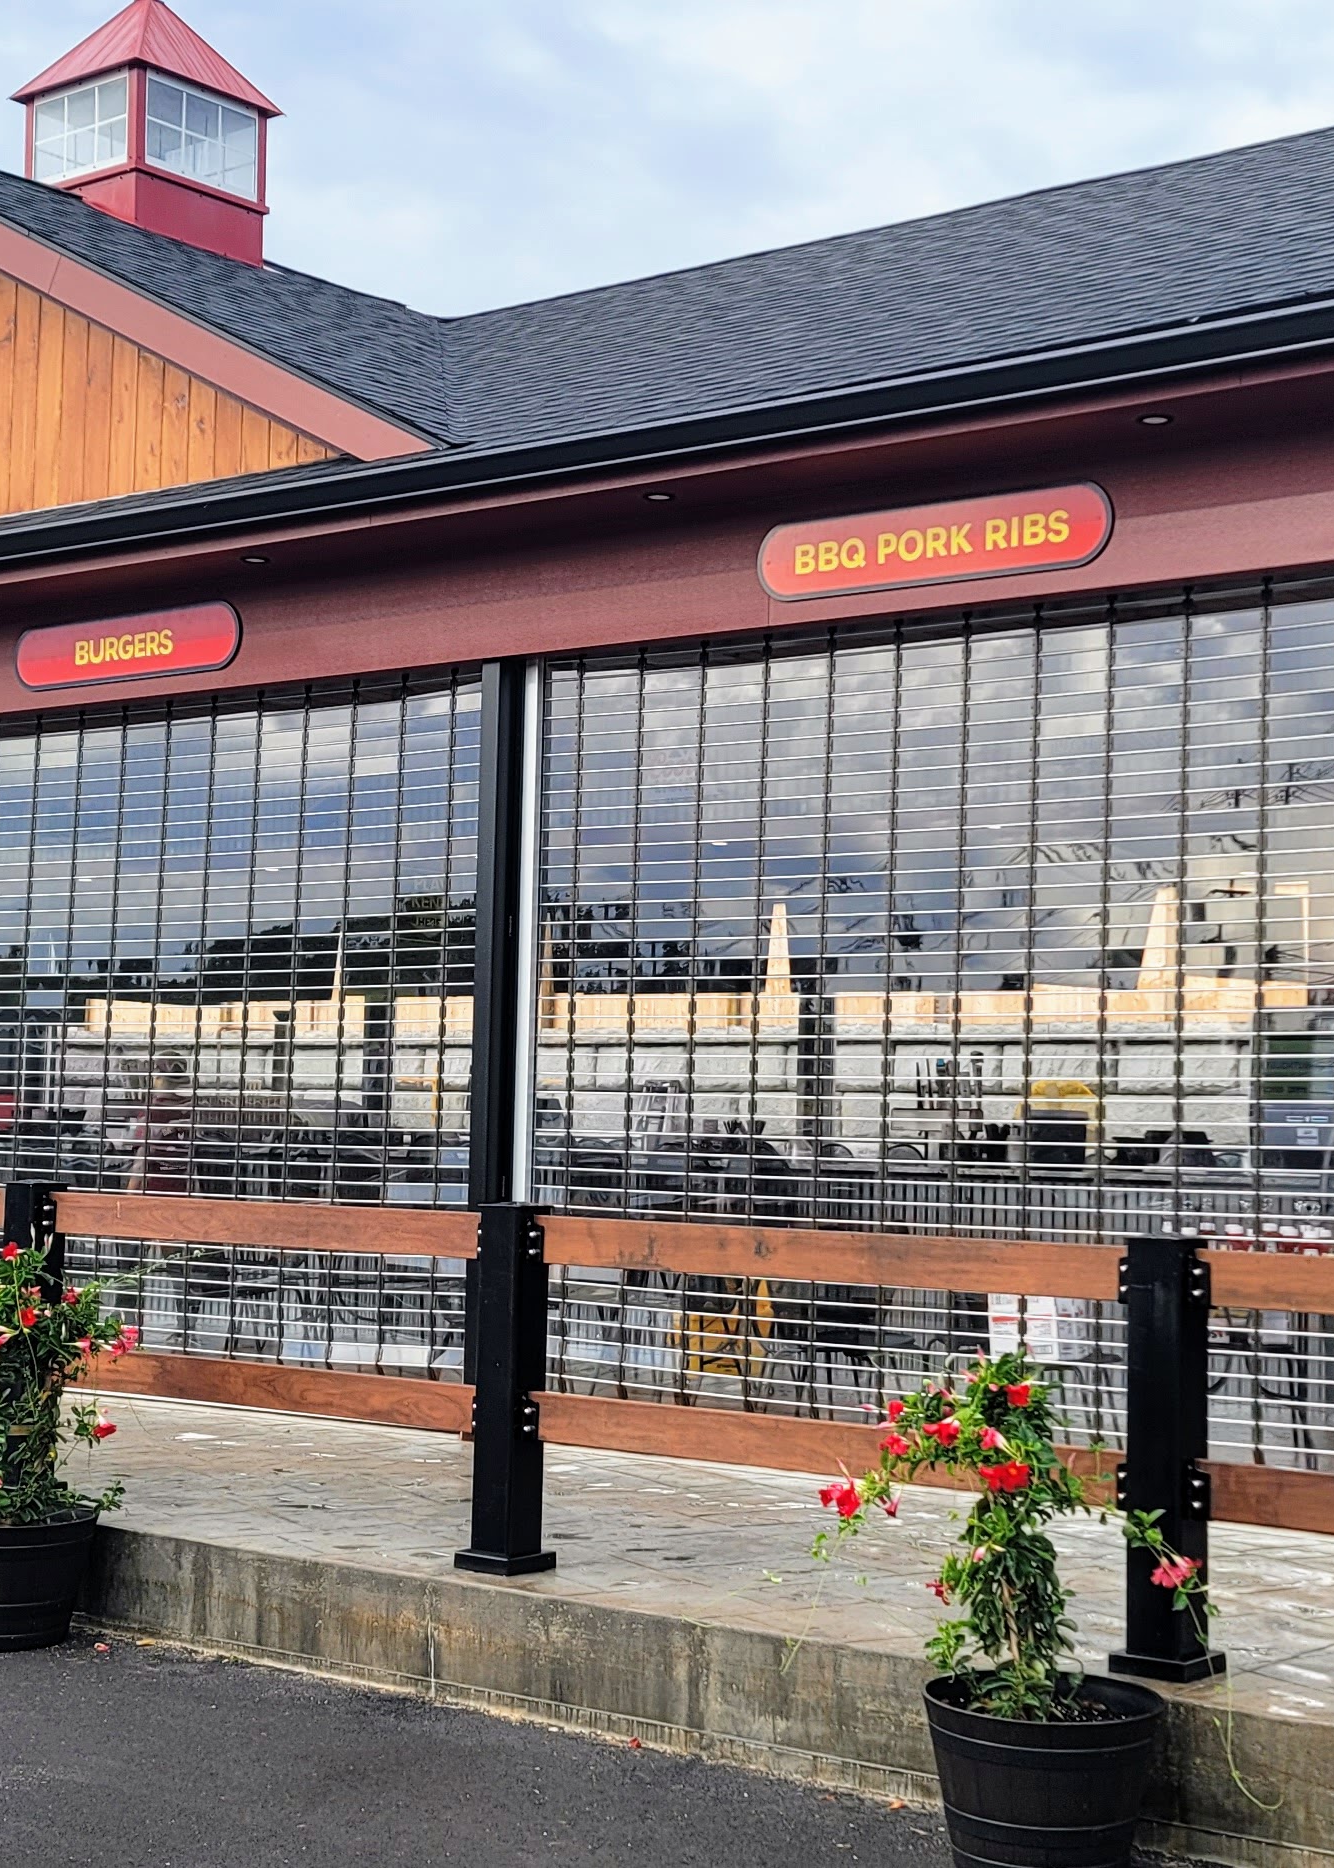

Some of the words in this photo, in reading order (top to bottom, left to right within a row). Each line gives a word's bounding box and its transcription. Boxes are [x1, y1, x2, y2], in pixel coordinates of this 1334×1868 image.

[794, 538, 867, 576] BBQ
[877, 522, 974, 565] PORK
[984, 509, 1071, 551] RIBS
[74, 628, 174, 667] BURGERS
